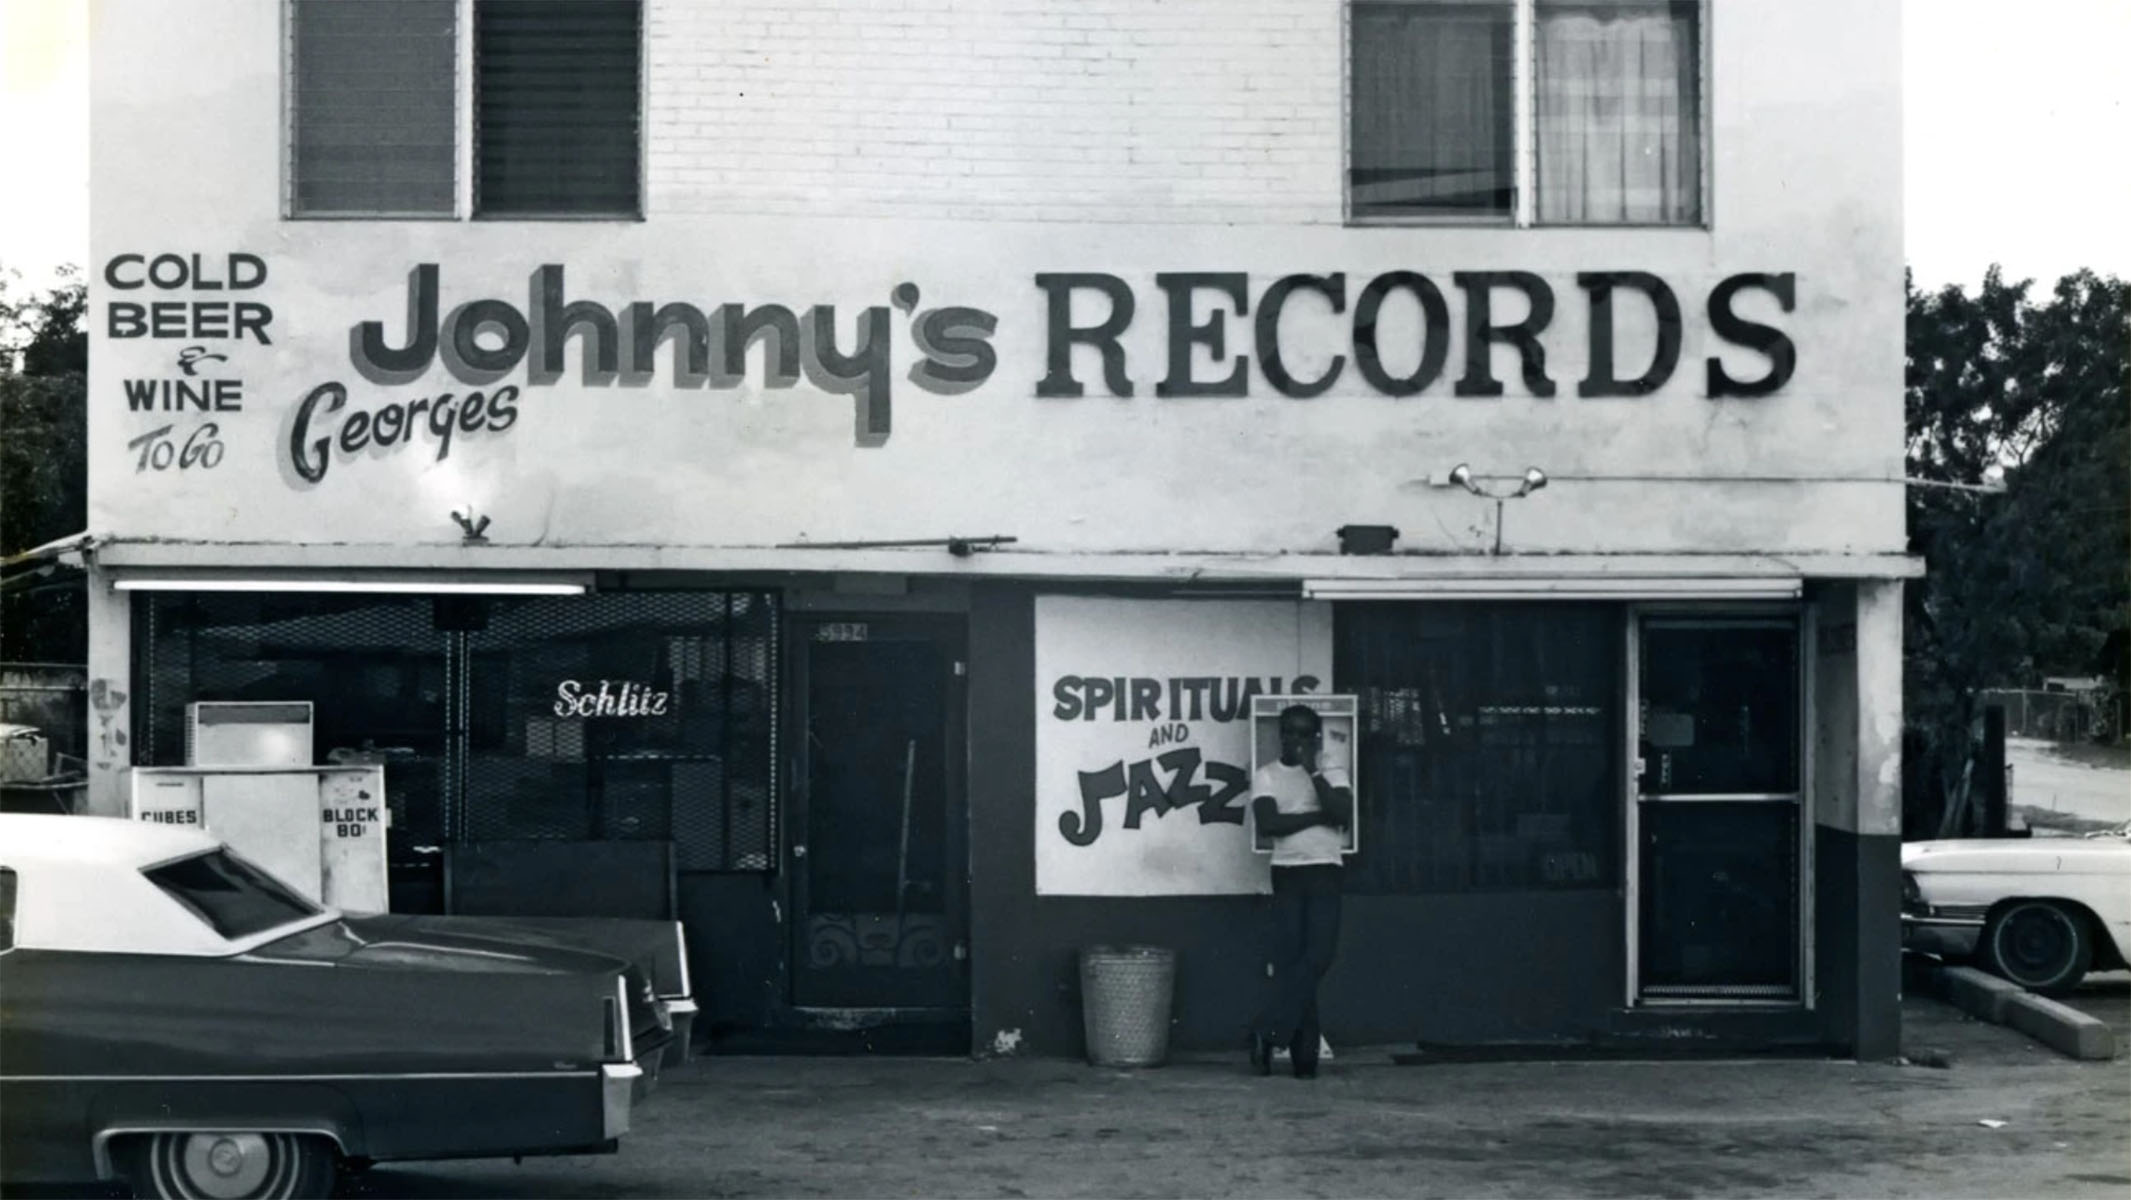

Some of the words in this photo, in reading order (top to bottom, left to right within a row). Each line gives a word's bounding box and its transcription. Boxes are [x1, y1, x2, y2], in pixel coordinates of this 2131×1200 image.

[104, 252, 268, 291] COLD
[108, 301, 274, 345] BEER
[177, 346, 229, 376] &
[350, 263, 998, 448] Johnny's
[1035, 270, 1798, 399] RECORDS
[124, 380, 243, 412] WINE
[279, 381, 520, 491] Georges
[553, 679, 669, 717] Schlitz
[1149, 722, 1190, 749] AND
[323, 808, 379, 824] BLOCK
[1058, 747, 1250, 847] JAZZ
